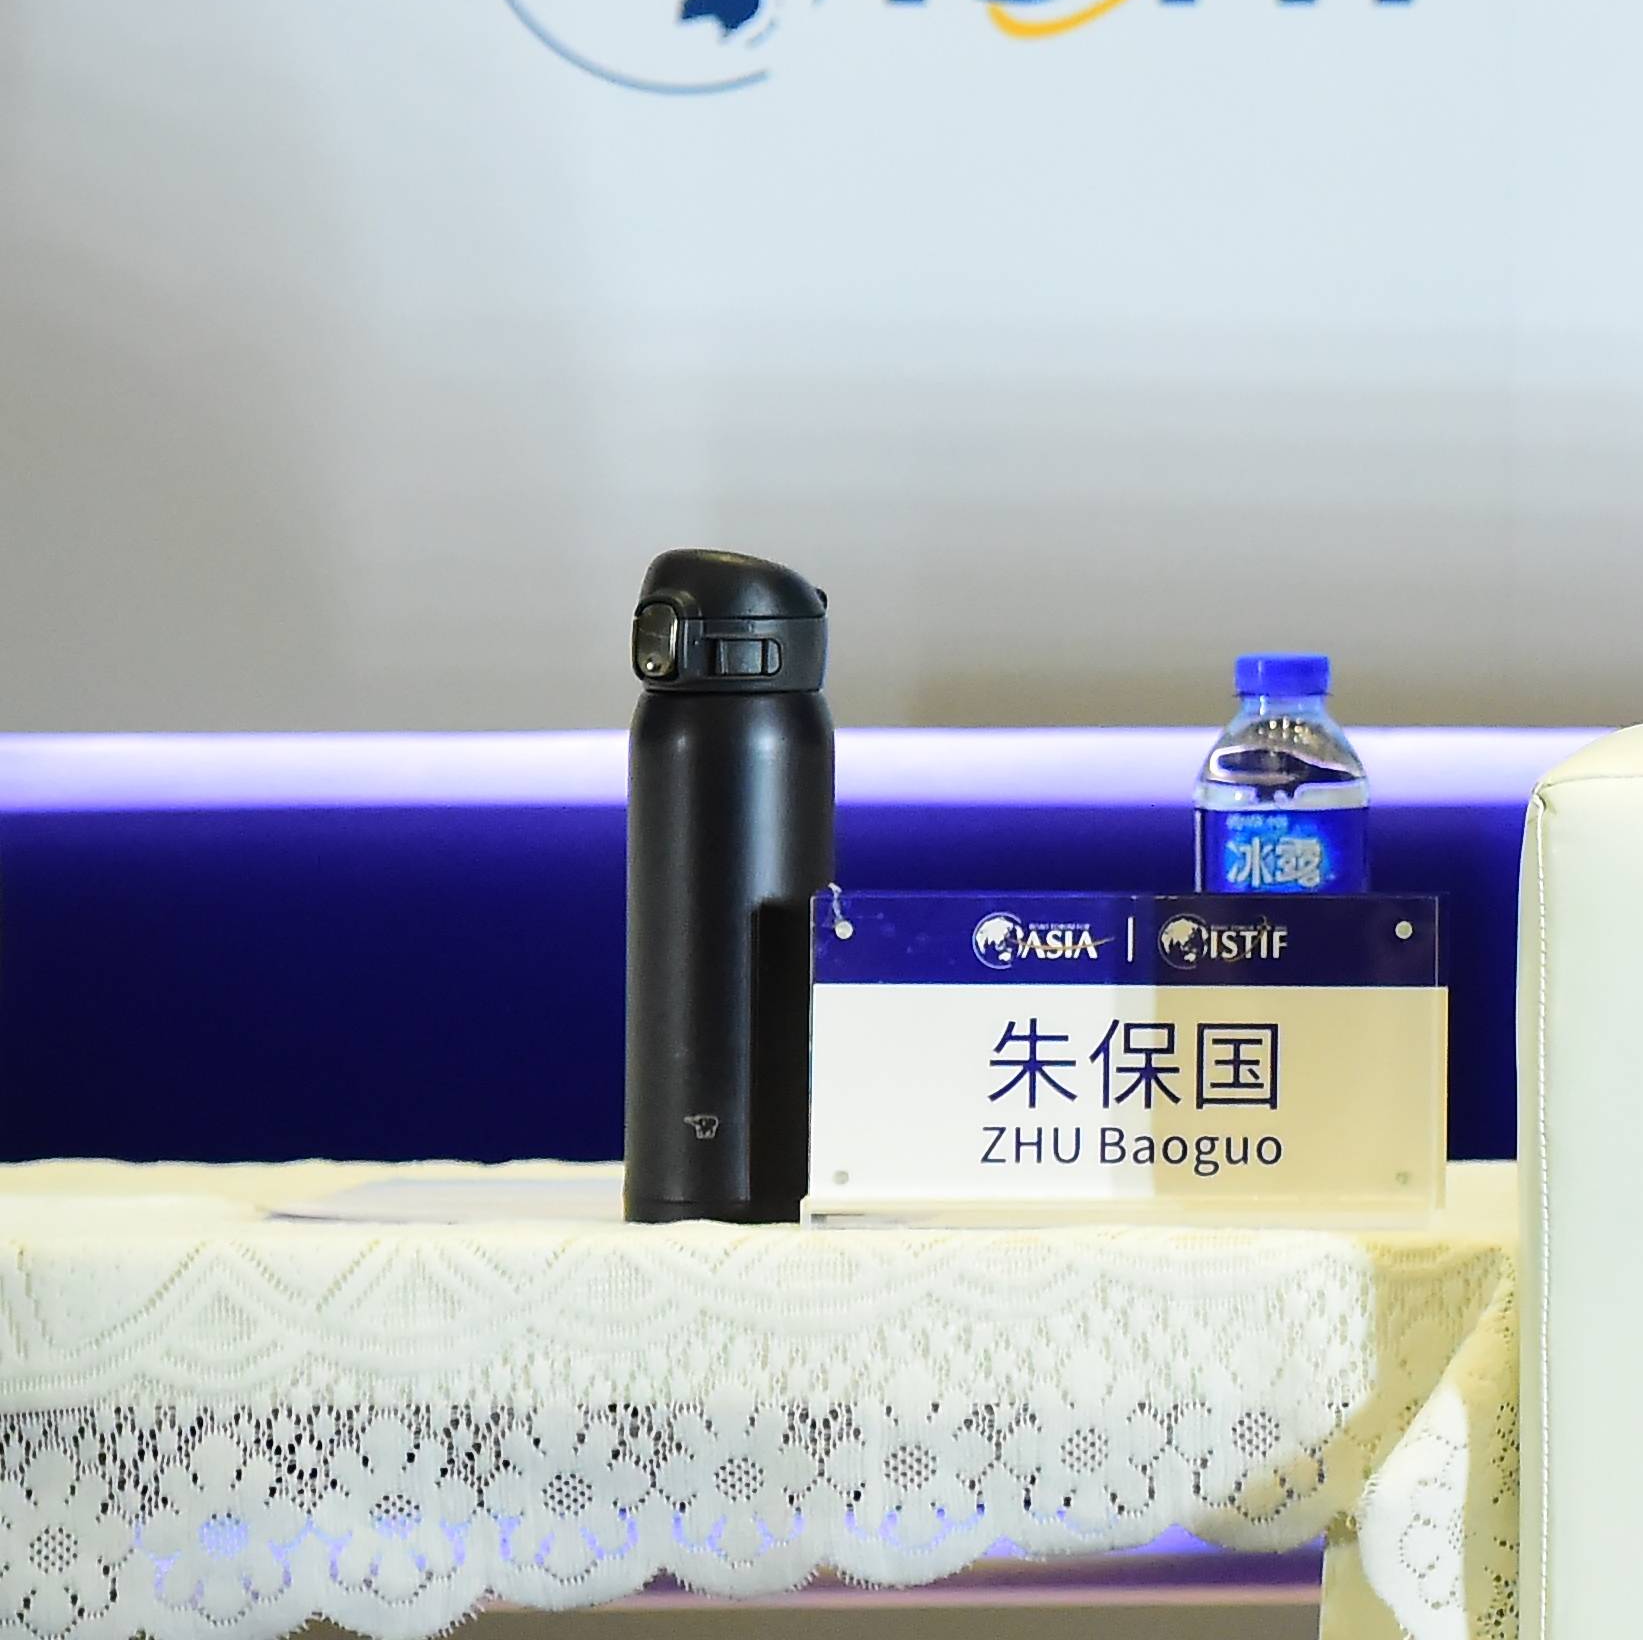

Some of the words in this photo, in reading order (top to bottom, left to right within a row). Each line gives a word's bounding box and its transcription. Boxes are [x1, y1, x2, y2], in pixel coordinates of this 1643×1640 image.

[1226, 837, 1321, 888] 冰露
[1021, 930, 1098, 959] ASIA
[1211, 931, 1287, 959] ISTIF
[989, 1018, 1280, 1110] 朱保国
[981, 1127, 1082, 1165] ZHU
[1099, 1127, 1284, 1176] Baoguo
